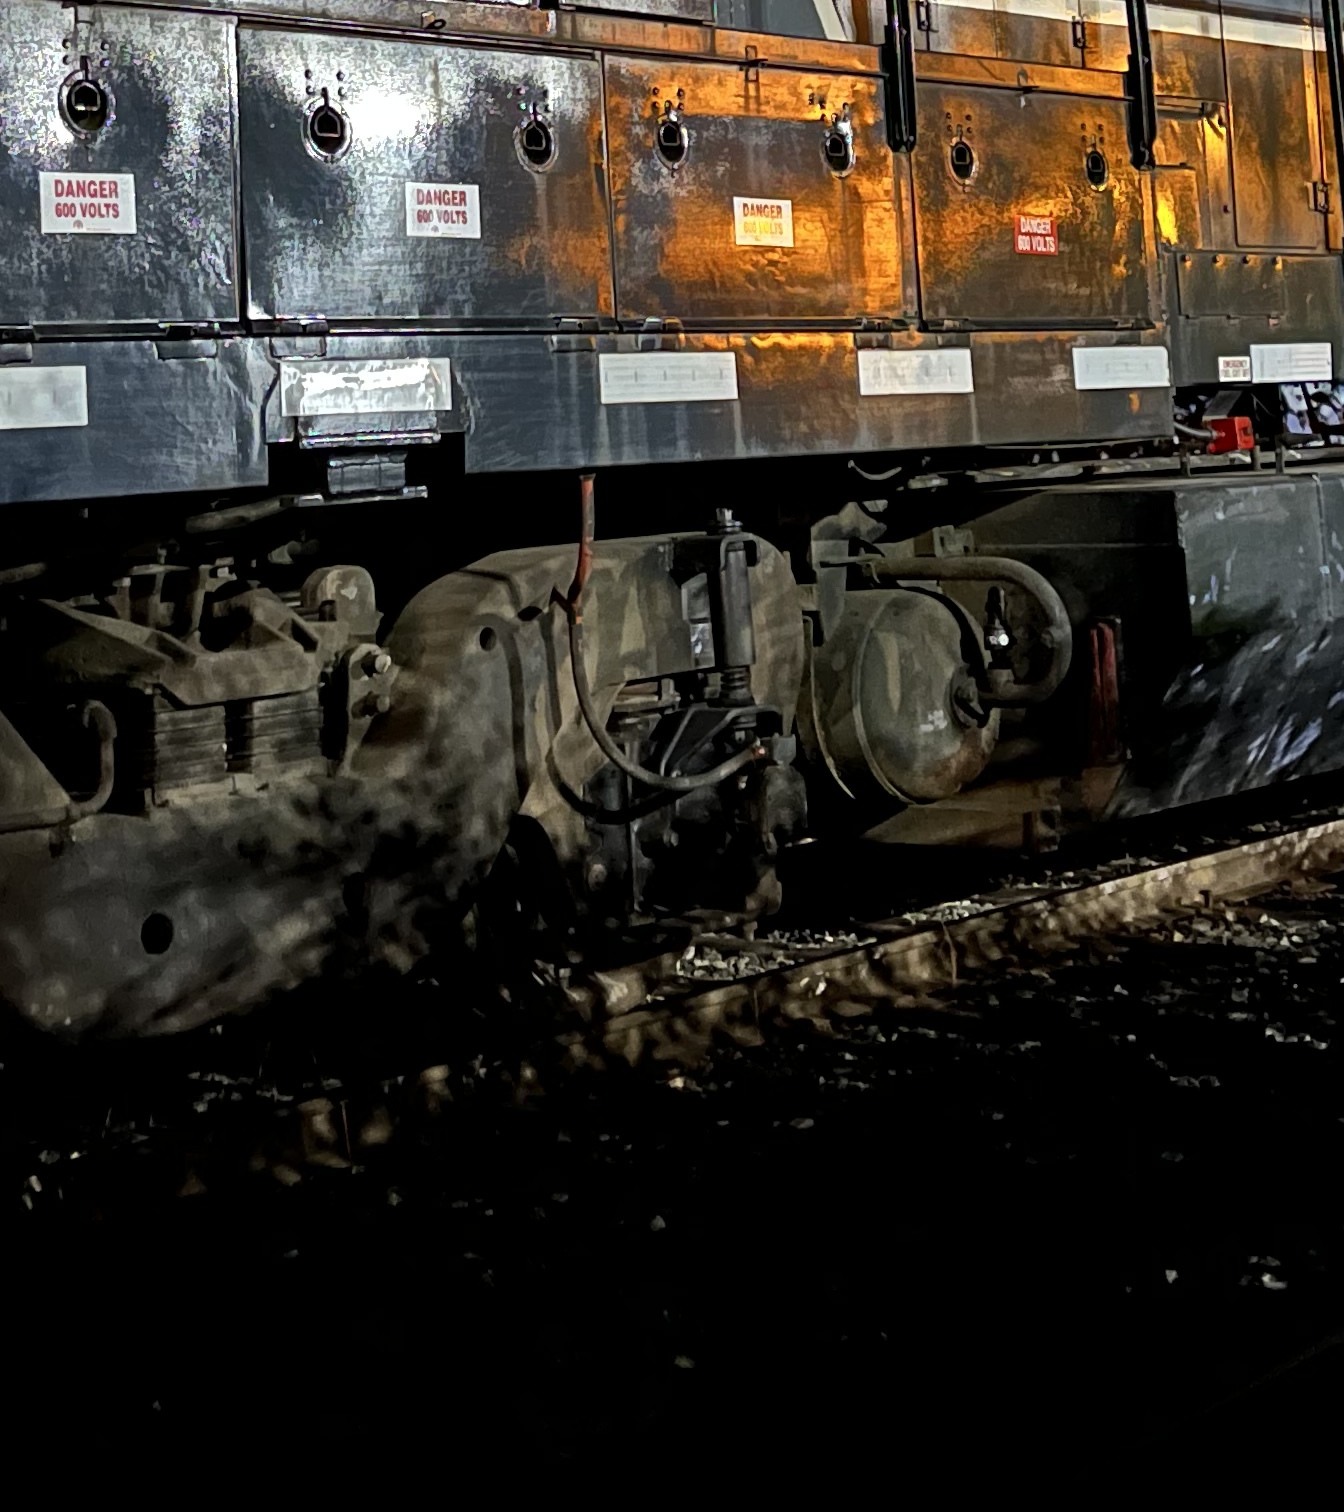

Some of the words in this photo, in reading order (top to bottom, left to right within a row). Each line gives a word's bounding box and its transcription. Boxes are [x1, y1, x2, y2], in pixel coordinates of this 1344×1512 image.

[54, 179, 119, 199] DANGER
[416, 188, 467, 207] DANGER
[55, 202, 77, 218] 600
[79, 202, 120, 219] VOLTS
[416, 209, 434, 223] 600
[436, 209, 468, 225] VOLTS
[742, 202, 783, 220] DANGER
[1020, 216, 1052, 235] DANGER
[1031, 235, 1056, 253] VOLTS
